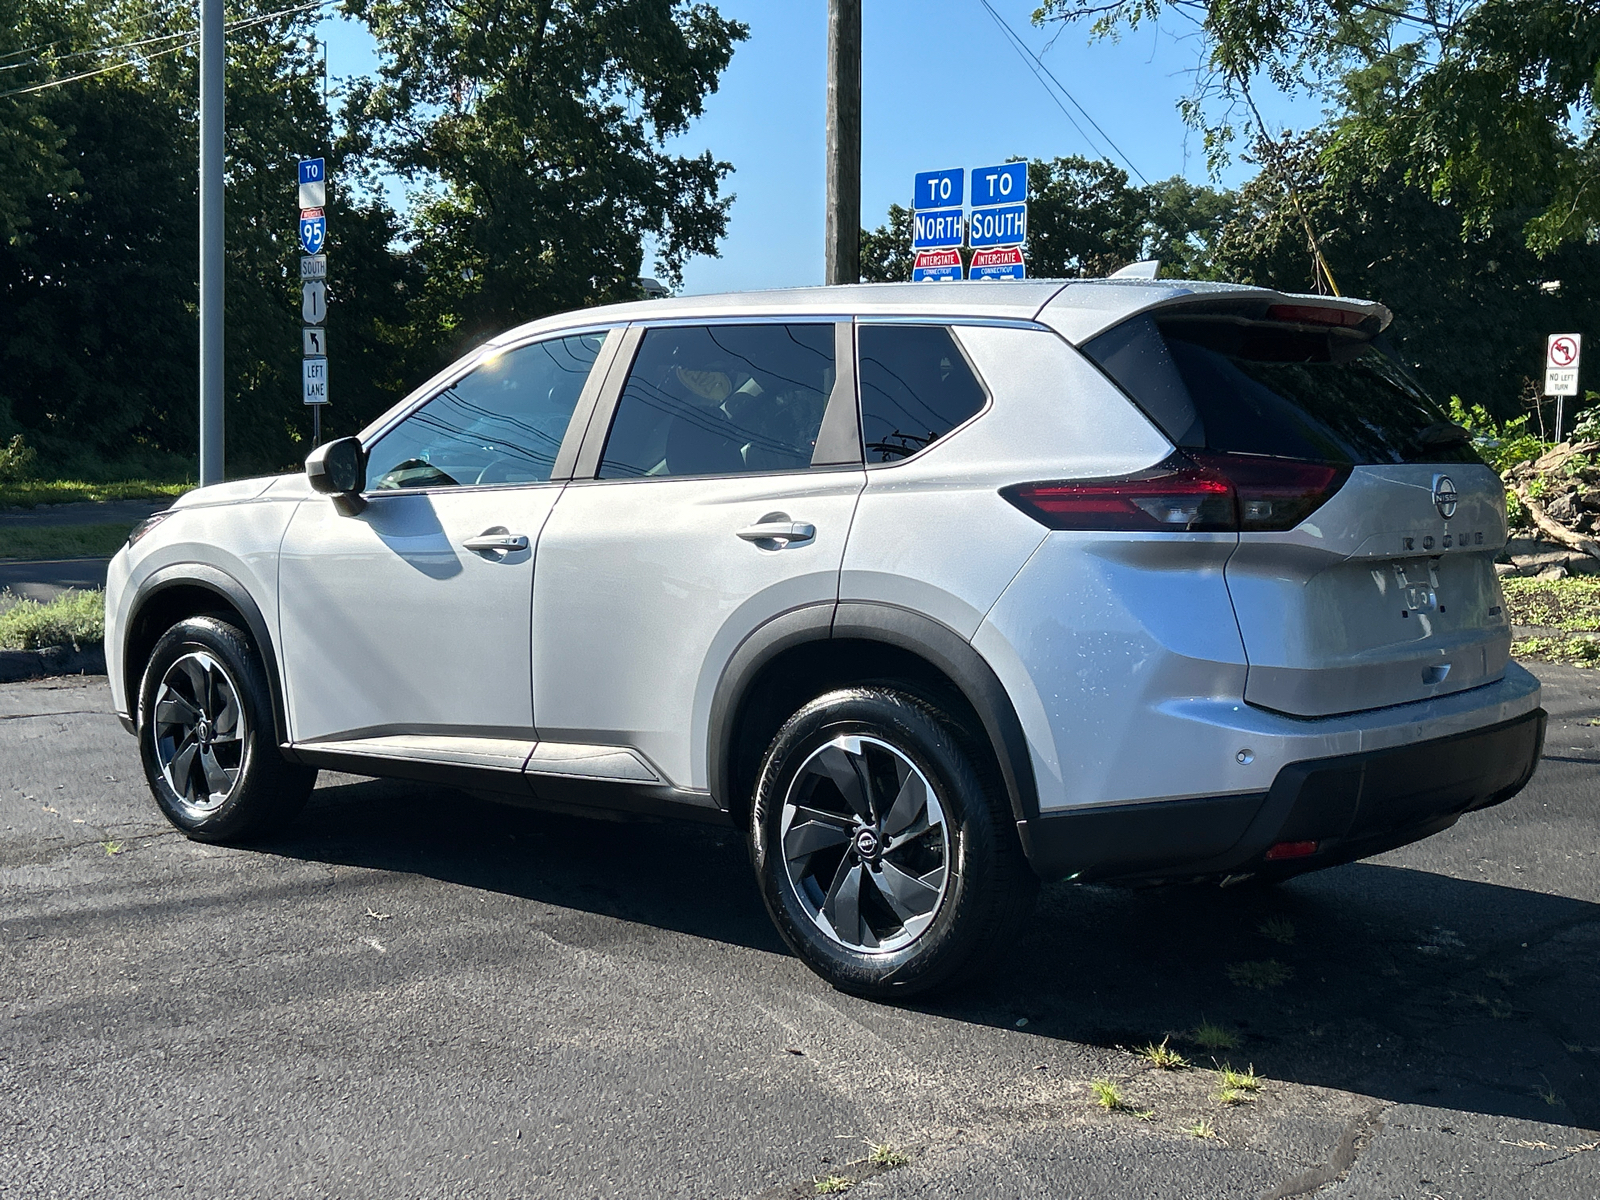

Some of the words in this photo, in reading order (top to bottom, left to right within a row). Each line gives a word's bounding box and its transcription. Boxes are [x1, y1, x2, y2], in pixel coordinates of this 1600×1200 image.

[305, 164, 318, 179] TO
[927, 177, 952, 201] TO
[985, 172, 1013, 197] TO
[915, 215, 962, 241] NORTH
[972, 212, 1024, 239] SOUTH
[303, 222, 322, 245] 95
[920, 254, 955, 266] INTERSTATE
[977, 252, 1016, 265] INTERSTATE
[302, 260, 325, 275] SOUTH
[922, 267, 952, 276] CONNECTICUT
[980, 266, 1013, 275] CONNECTICUT
[312, 291, 317, 316] 1
[307, 365, 323, 379] LEFT
[1549, 373, 1559, 381] NO
[307, 383, 324, 396] LANE
[1402, 531, 1484, 551] ROGUE
